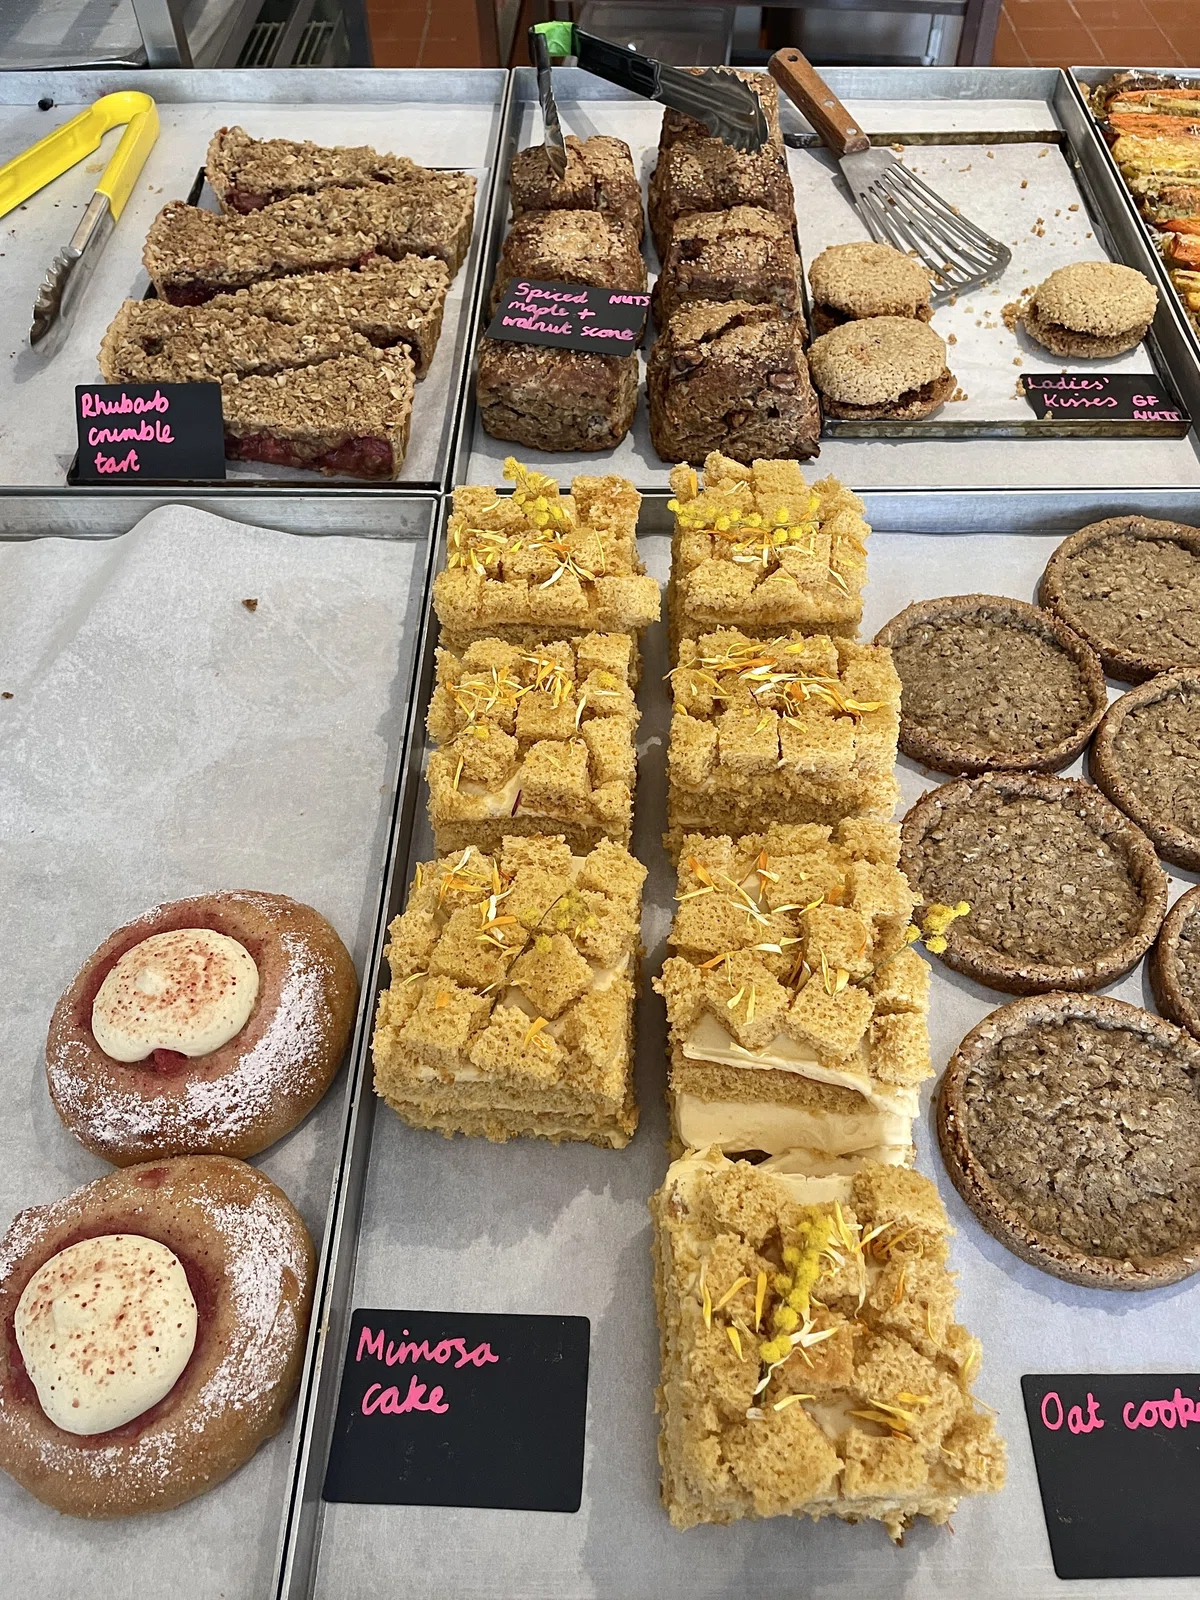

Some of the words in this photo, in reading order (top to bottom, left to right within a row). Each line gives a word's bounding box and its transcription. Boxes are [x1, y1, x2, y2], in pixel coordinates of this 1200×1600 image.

[514, 282, 589, 304] Spiced
[608, 294, 651, 306] NUTS
[508, 300, 570, 320] maple
[577, 308, 596, 320] +
[502, 315, 573, 335] walnut
[580, 325, 637, 341] scone
[1027, 377, 1110, 390] Ladies'
[81, 389, 170, 418] Rhubarb
[1043, 393, 1118, 407] Kisses
[1132, 394, 1160, 406] GF
[88, 420, 175, 447] crumble
[94, 449, 141, 474] tart
[355, 1326, 499, 1369] Mimosa
[361, 1374, 450, 1416] cake
[1040, 1391, 1105, 1435] Oat
[1122, 1387, 1200, 1430] cook
